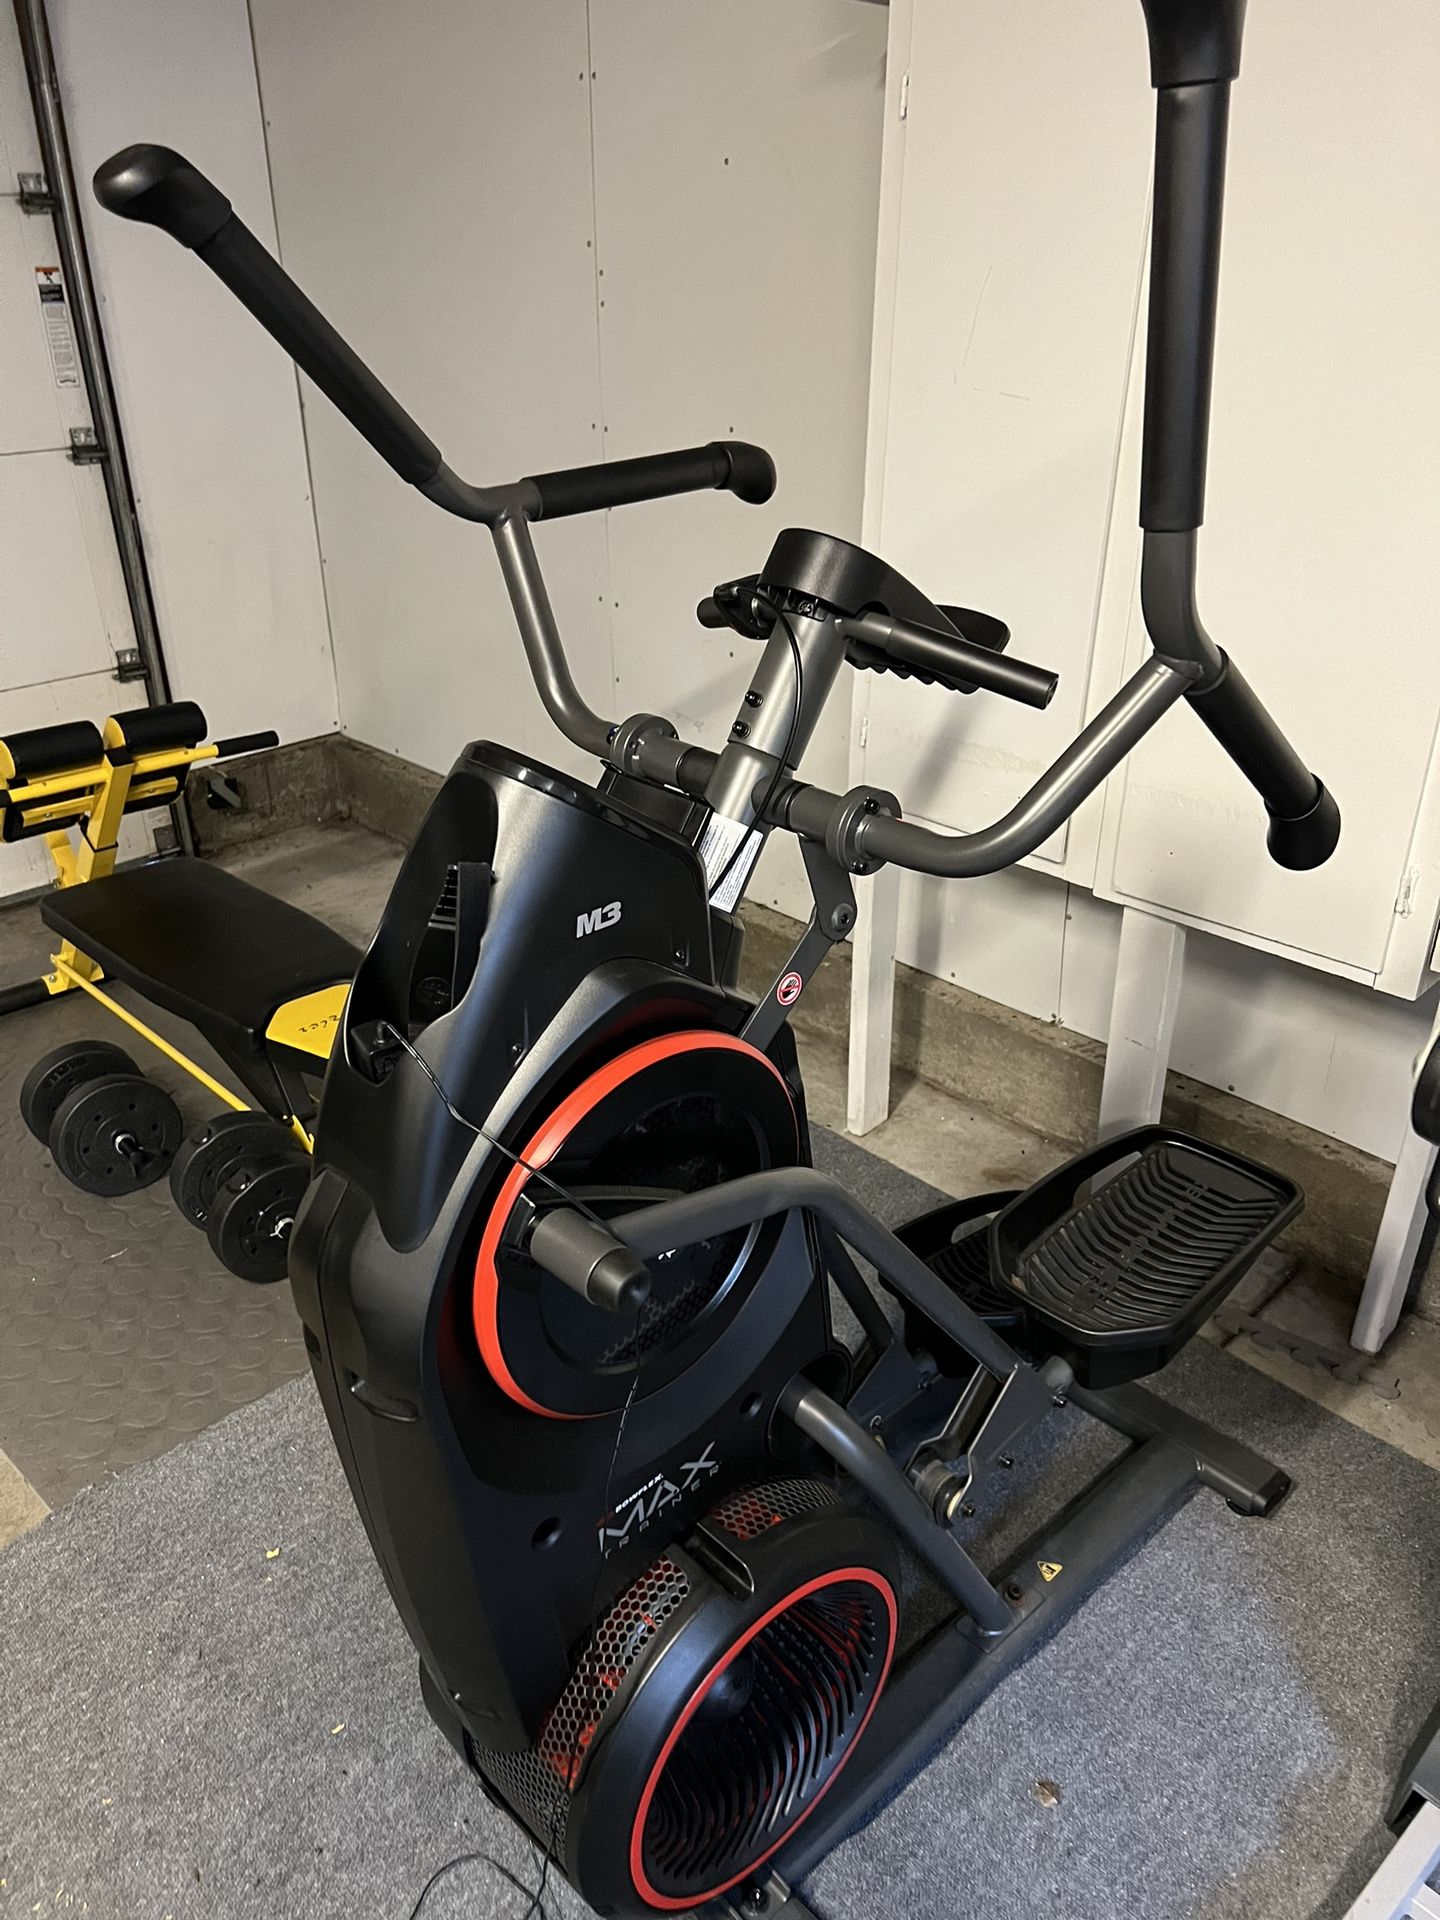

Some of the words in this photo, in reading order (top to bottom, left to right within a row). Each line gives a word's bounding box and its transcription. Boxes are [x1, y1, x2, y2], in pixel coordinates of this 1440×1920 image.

[576, 901, 622, 939] M3
[598, 1441, 716, 1553] MAX
[604, 1463, 719, 1559] TRAINER
